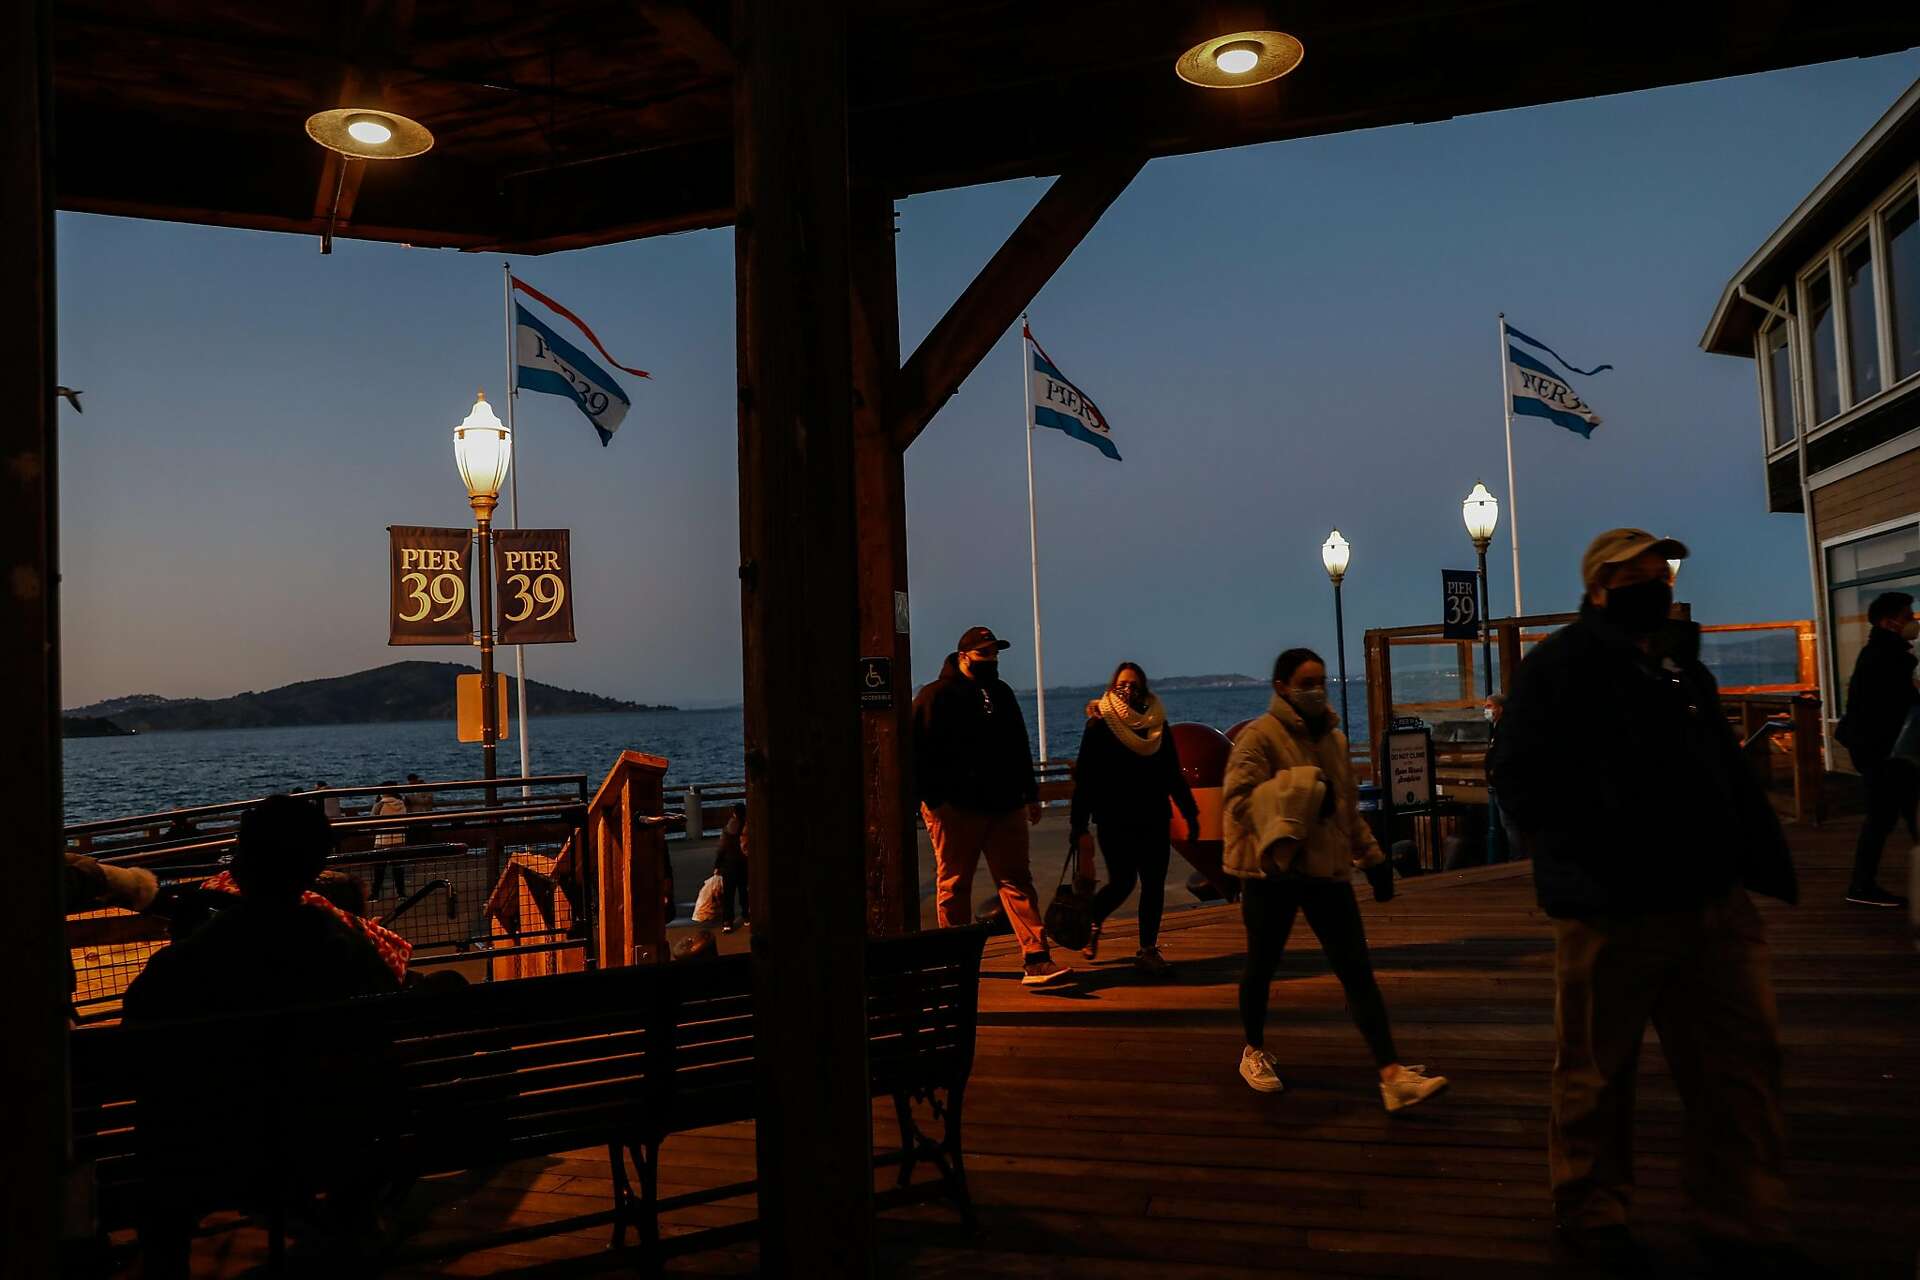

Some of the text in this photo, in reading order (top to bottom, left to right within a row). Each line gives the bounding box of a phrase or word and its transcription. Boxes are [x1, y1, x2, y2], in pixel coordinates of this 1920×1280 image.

[401, 548, 463, 571] PIER
[504, 551, 562, 572] PIER
[398, 572, 465, 622] 39
[504, 573, 565, 622] 39
[1447, 581, 1473, 595] PIER
[1446, 595, 1475, 625] 39
